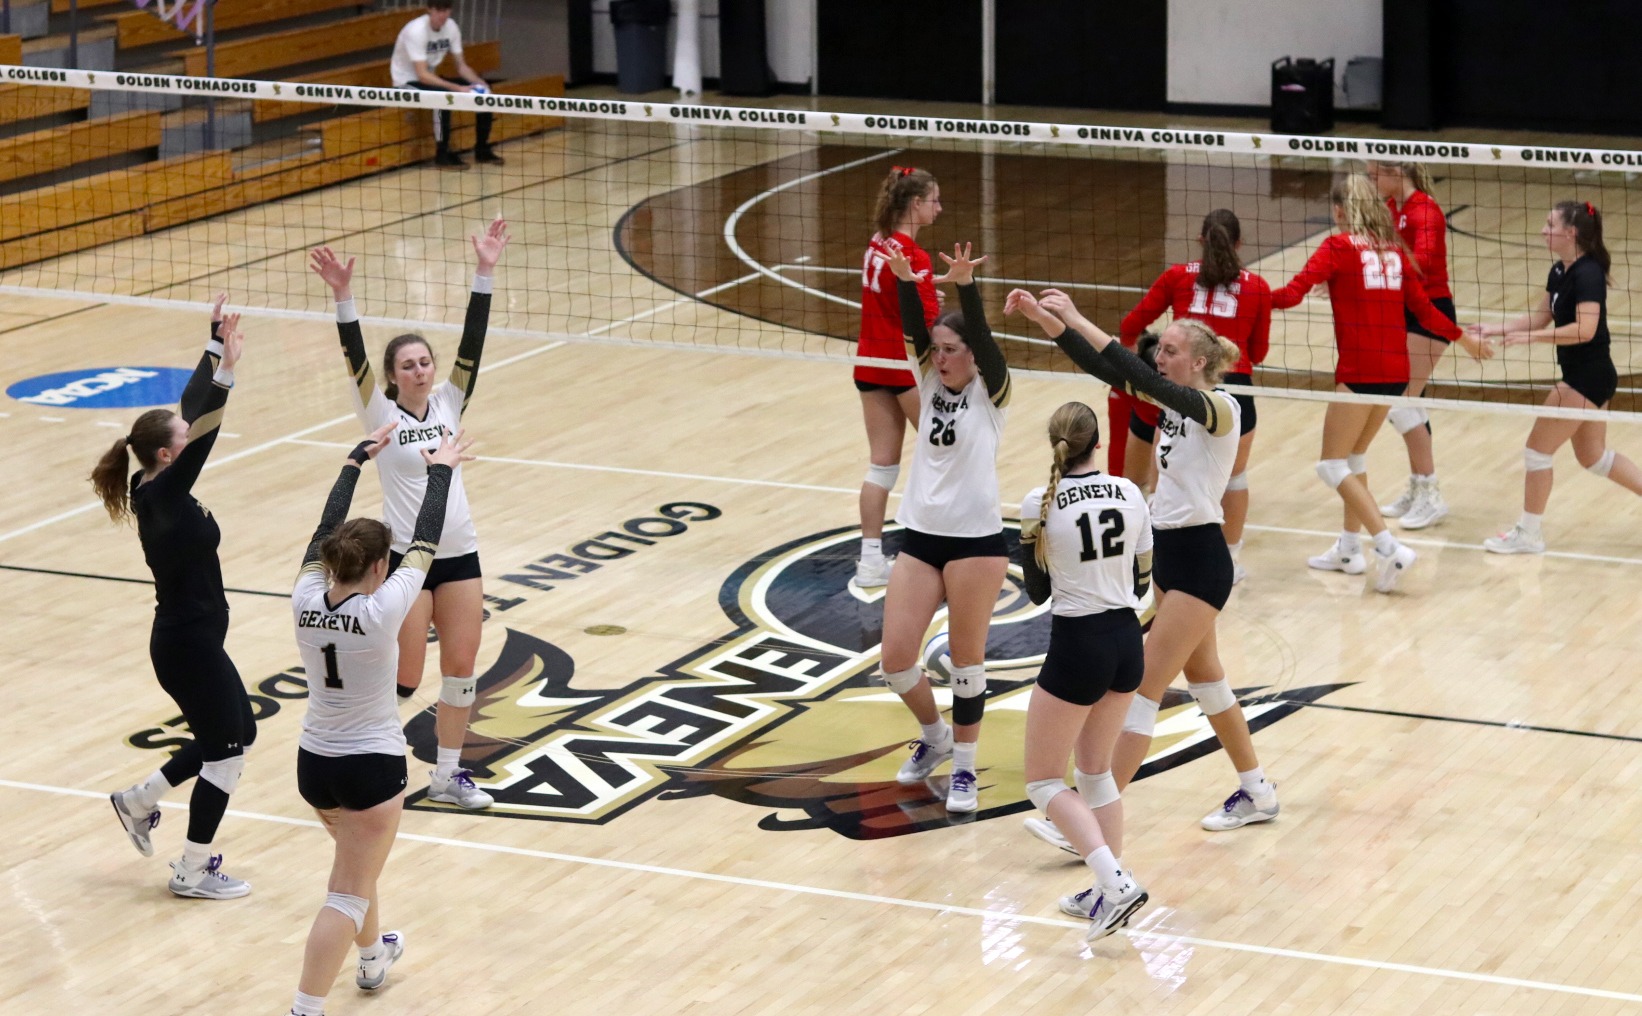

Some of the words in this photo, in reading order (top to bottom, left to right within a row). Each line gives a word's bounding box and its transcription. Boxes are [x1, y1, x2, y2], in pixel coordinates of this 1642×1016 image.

[8, 69, 67, 82] COLLEGE
[116, 75, 171, 89] GOLDEN
[175, 78, 257, 94] TORNADOES
[295, 86, 353, 100] GENEVA
[358, 89, 420, 103] COLLEGE
[474, 95, 533, 110] GOLDEN
[539, 99, 628, 115] TORNADOES
[670, 106, 733, 121] GENEVA
[739, 110, 807, 125] COLLEGE
[864, 116, 929, 131] GOLDEN
[935, 120, 1031, 136] TORNADOES
[1077, 127, 1145, 142] GENEVA
[1151, 131, 1225, 147] COLLEGE
[1288, 138, 1358, 154] GOLDEN
[1365, 142, 1470, 159] TORNADOES
[1520, 149, 1594, 164] GENEVA
[1361, 249, 1403, 291] 22
[1188, 281, 1241, 318] 15
[929, 416, 956, 447] 26
[1057, 484, 1127, 510] GENEVA
[1076, 508, 1126, 563] 12
[498, 501, 723, 592] GOLDEN
[298, 610, 367, 636] GENEVA
[321, 642, 344, 690] 1
